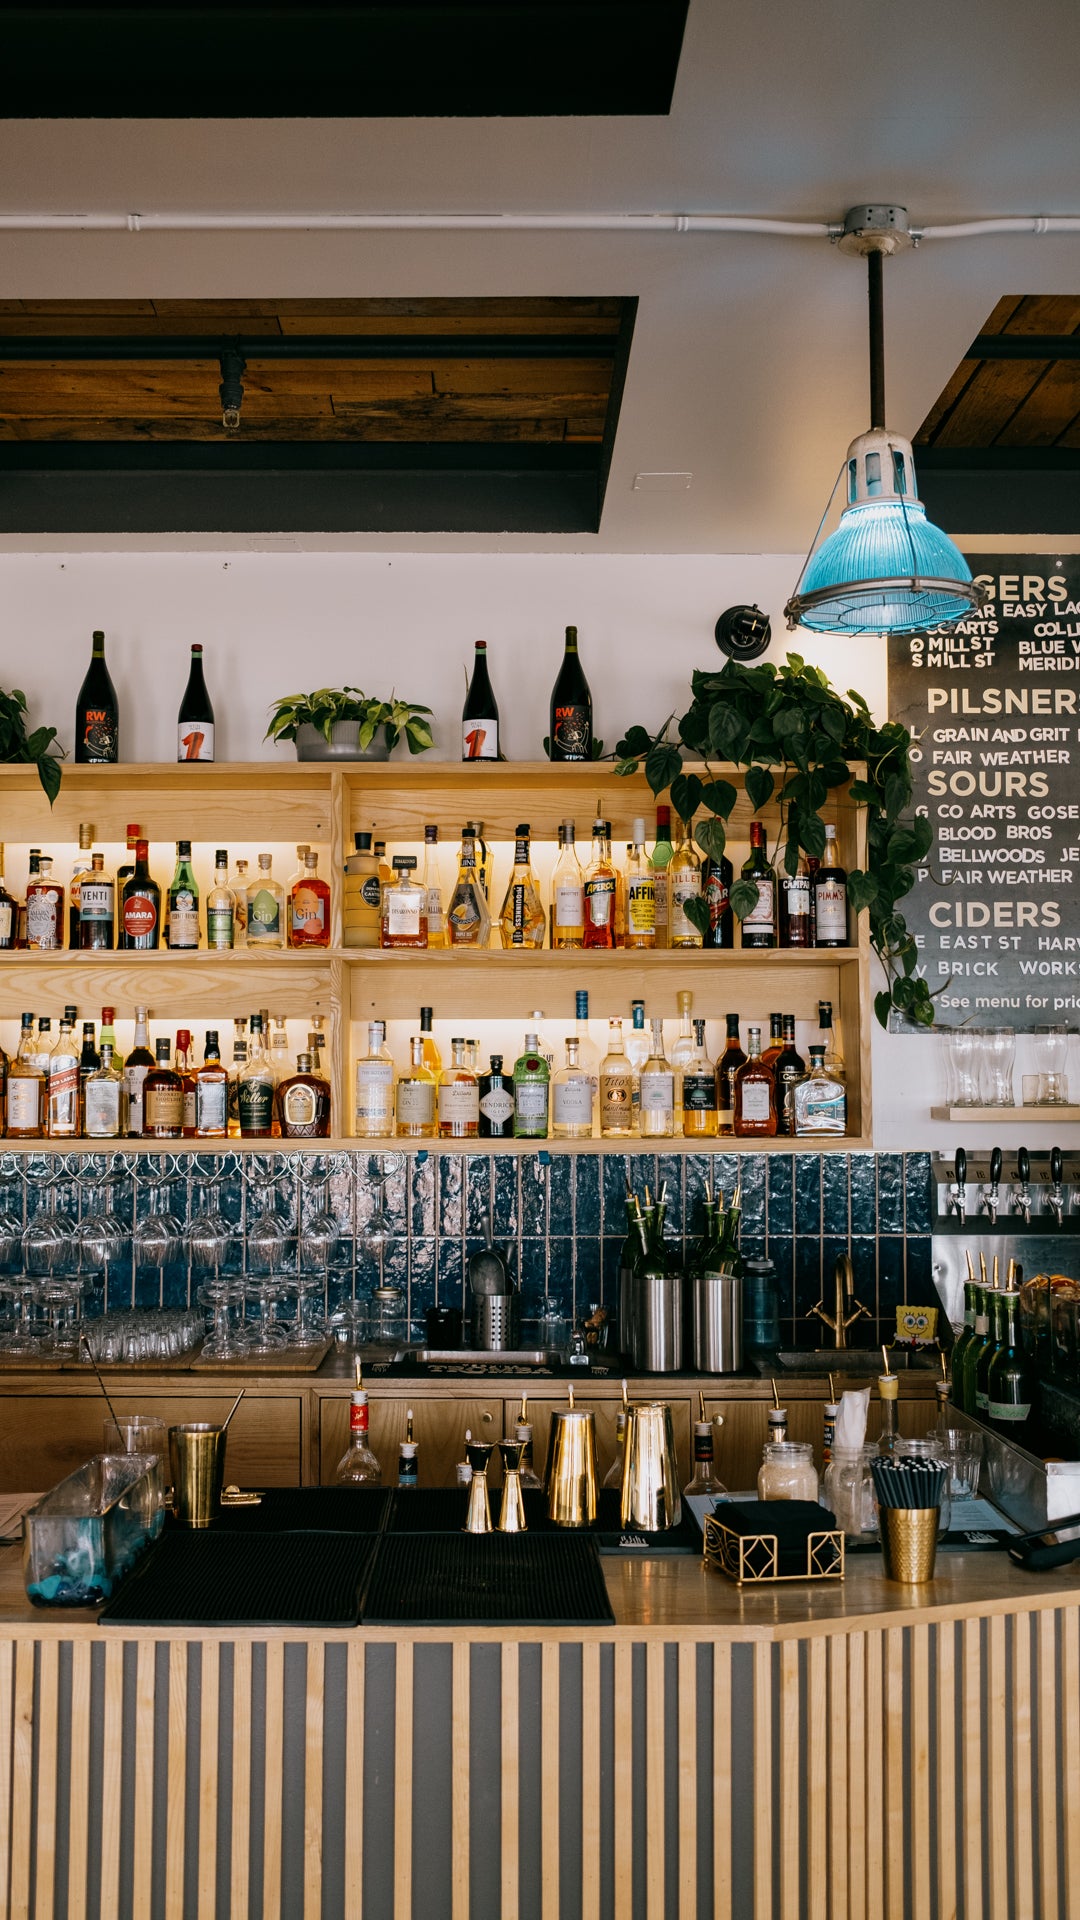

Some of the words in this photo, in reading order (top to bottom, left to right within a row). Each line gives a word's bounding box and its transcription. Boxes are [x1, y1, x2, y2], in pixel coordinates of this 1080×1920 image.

[972, 574, 1068, 602] GERS
[1003, 603, 1048, 618] EASY
[954, 621, 999, 635] ARTS
[1019, 640, 1065, 655] BLUE
[912, 653, 923, 667] S
[928, 652, 971, 669] MILL
[975, 652, 995, 668] ST
[928, 688, 1080, 715] PILSNER
[86, 711, 107, 721] RW
[555, 707, 575, 717] RW
[910, 725, 921, 739] L
[933, 728, 988, 743] GRAIN
[991, 728, 1027, 744] AND
[1029, 727, 1070, 742] GRIT
[908, 748, 923, 762] O
[932, 750, 972, 765] FAIR
[980, 750, 1070, 766] WEATHER
[927, 770, 1049, 798] SOURS
[937, 804, 963, 819] CO
[970, 804, 1016, 820] ARTS
[1027, 805, 1079, 820] GOSE
[938, 826, 996, 841] BLOOD
[1006, 825, 1052, 840] BROS
[939, 847, 1045, 864] BELLWOODS
[1060, 847, 1080, 862] JE
[672, 875, 700, 883] LILLET
[917, 868, 929, 882] P
[942, 869, 982, 884] FAIR
[987, 868, 1073, 884] WEATHER
[82, 891, 107, 900] VENTI
[586, 882, 614, 894] APEROL
[818, 890, 844, 900] PIMM'S
[296, 909, 317, 920] Gin
[928, 901, 1061, 928] CIDERS
[939, 935, 991, 949] EAST
[998, 936, 1021, 950] ST
[938, 961, 999, 976] BRICK
[976, 998, 1020, 1008] menu
[1026, 995, 1048, 1008] for
